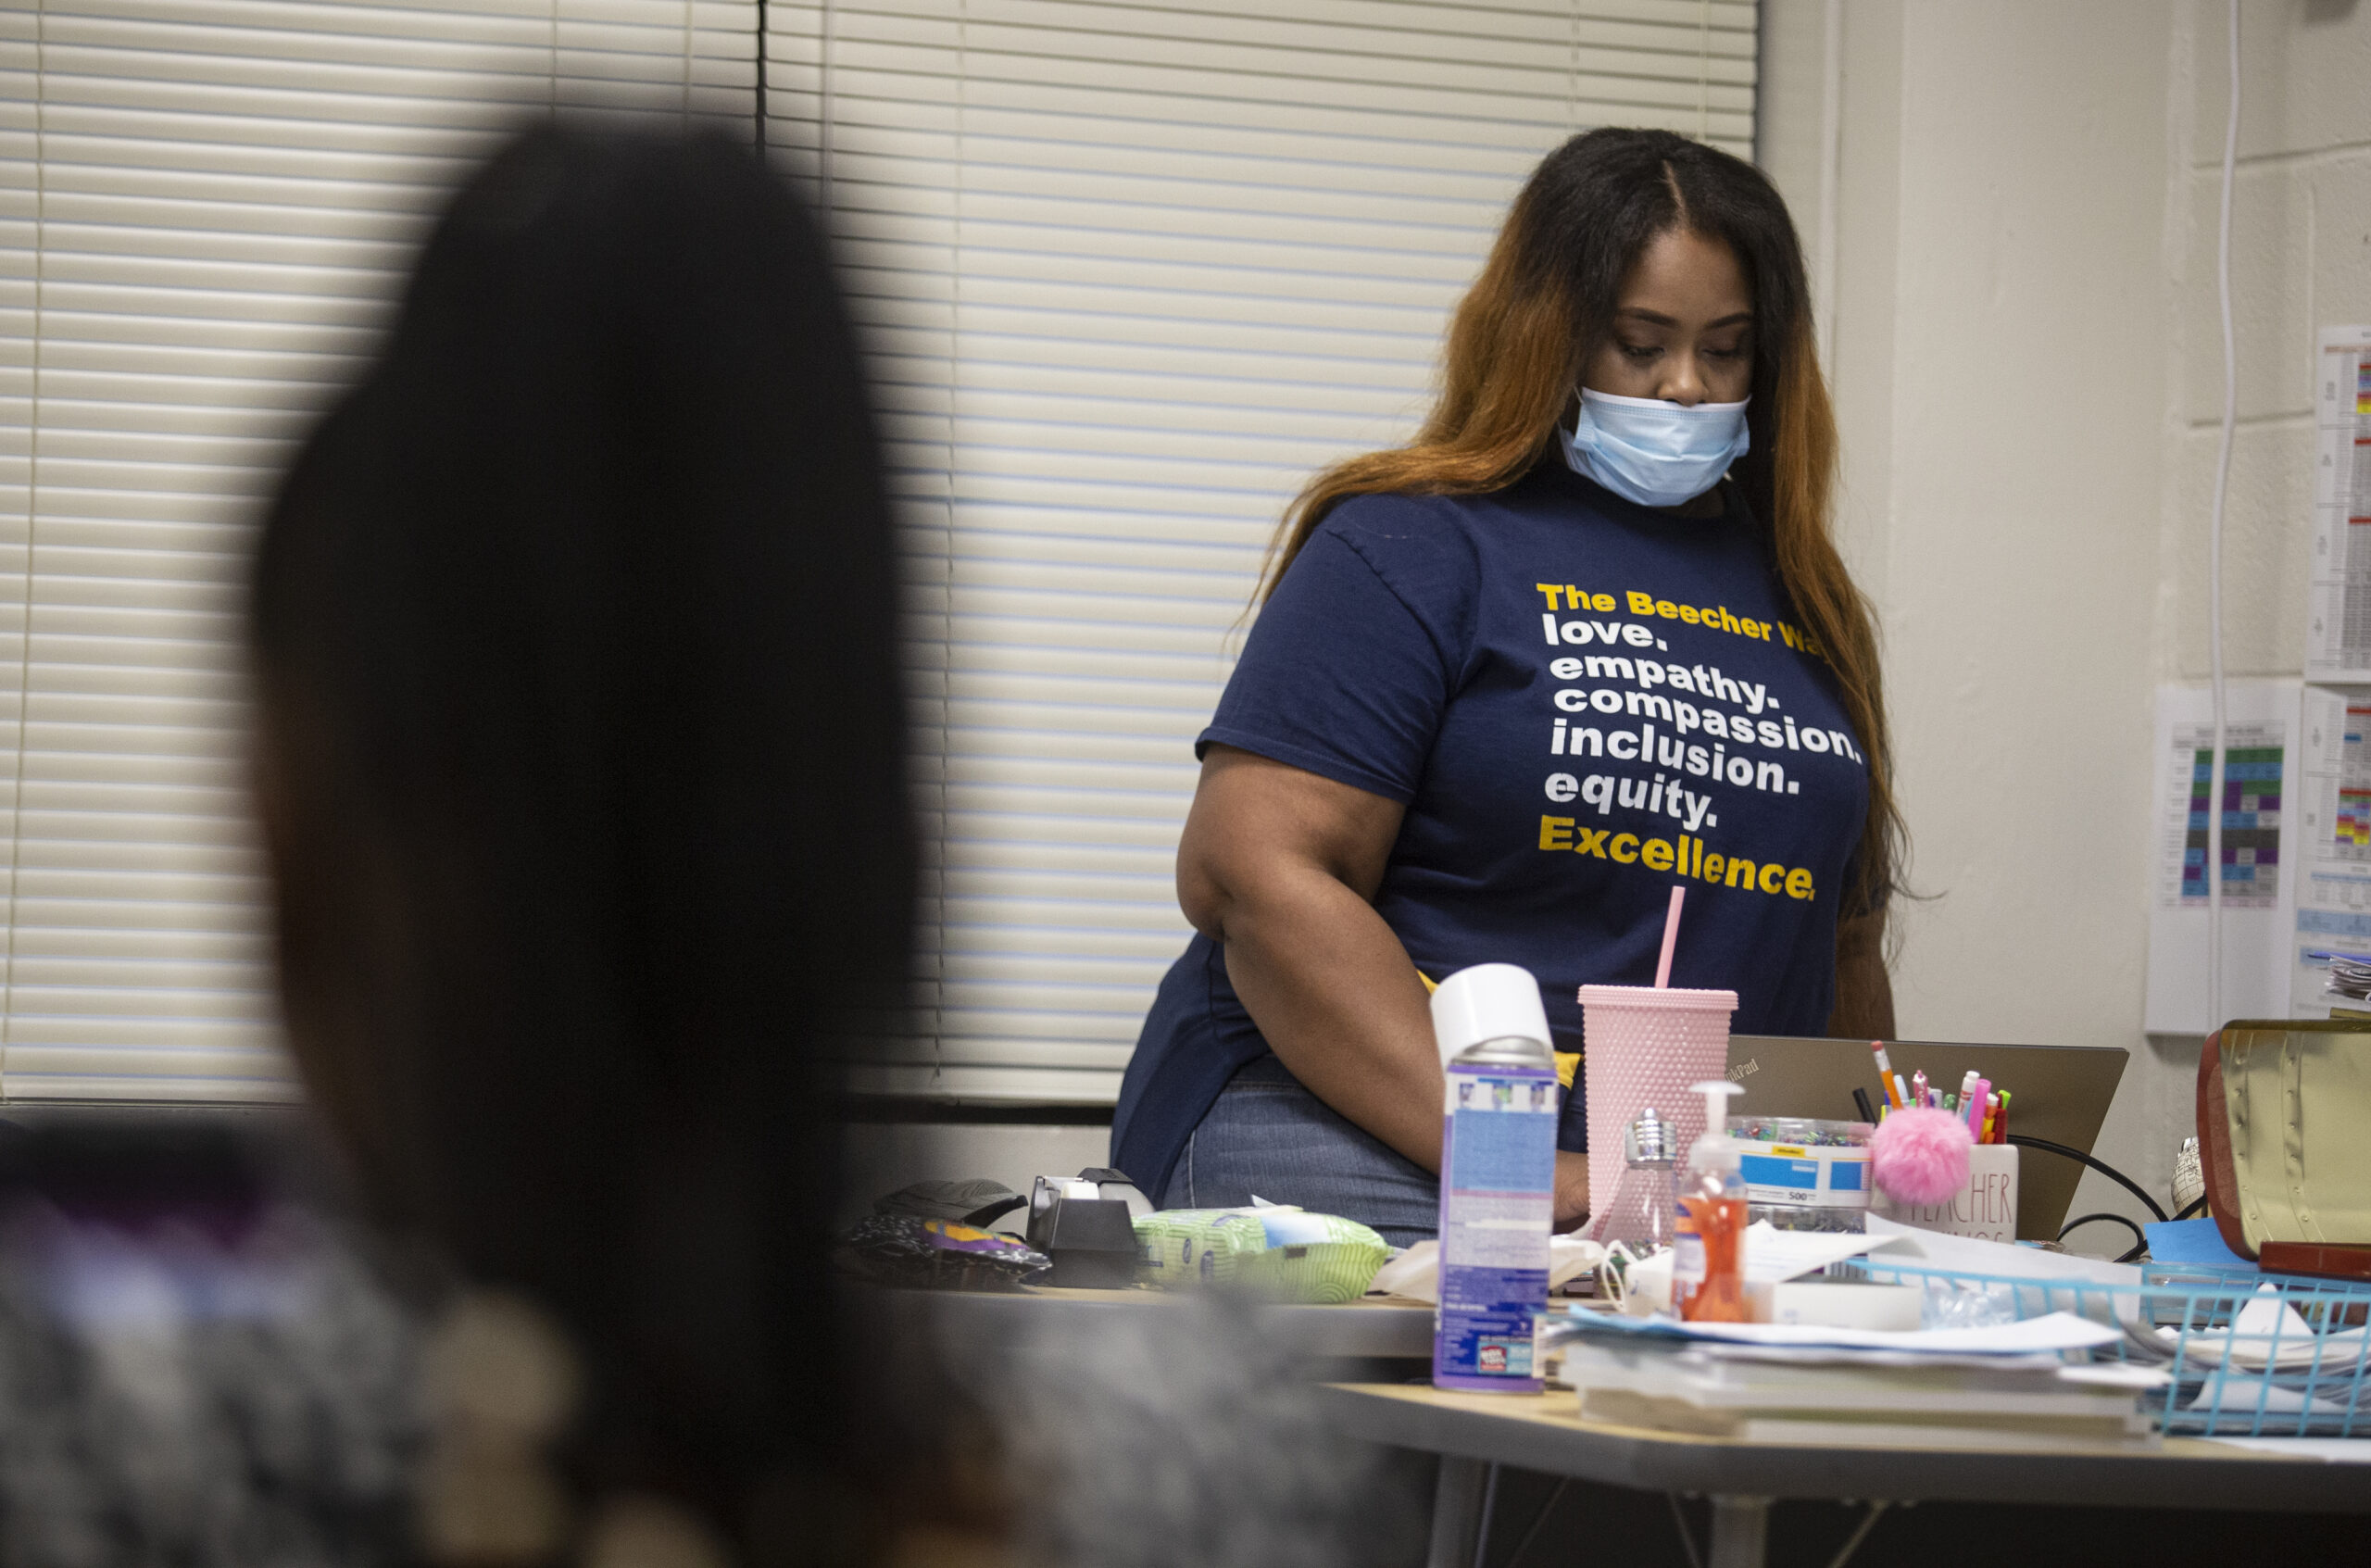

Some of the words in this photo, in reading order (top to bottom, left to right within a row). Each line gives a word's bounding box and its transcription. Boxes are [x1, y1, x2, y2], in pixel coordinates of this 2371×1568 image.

[1536, 583, 1616, 612] The
[1626, 590, 1773, 642] Beecher
[1542, 613, 1668, 652] love.
[1549, 655, 1780, 715] empathy.
[1550, 718, 1800, 795] inclusion.
[1553, 687, 1863, 765] compassion.
[1544, 771, 1717, 832] equity.
[1538, 814, 1814, 901] Excellence.
